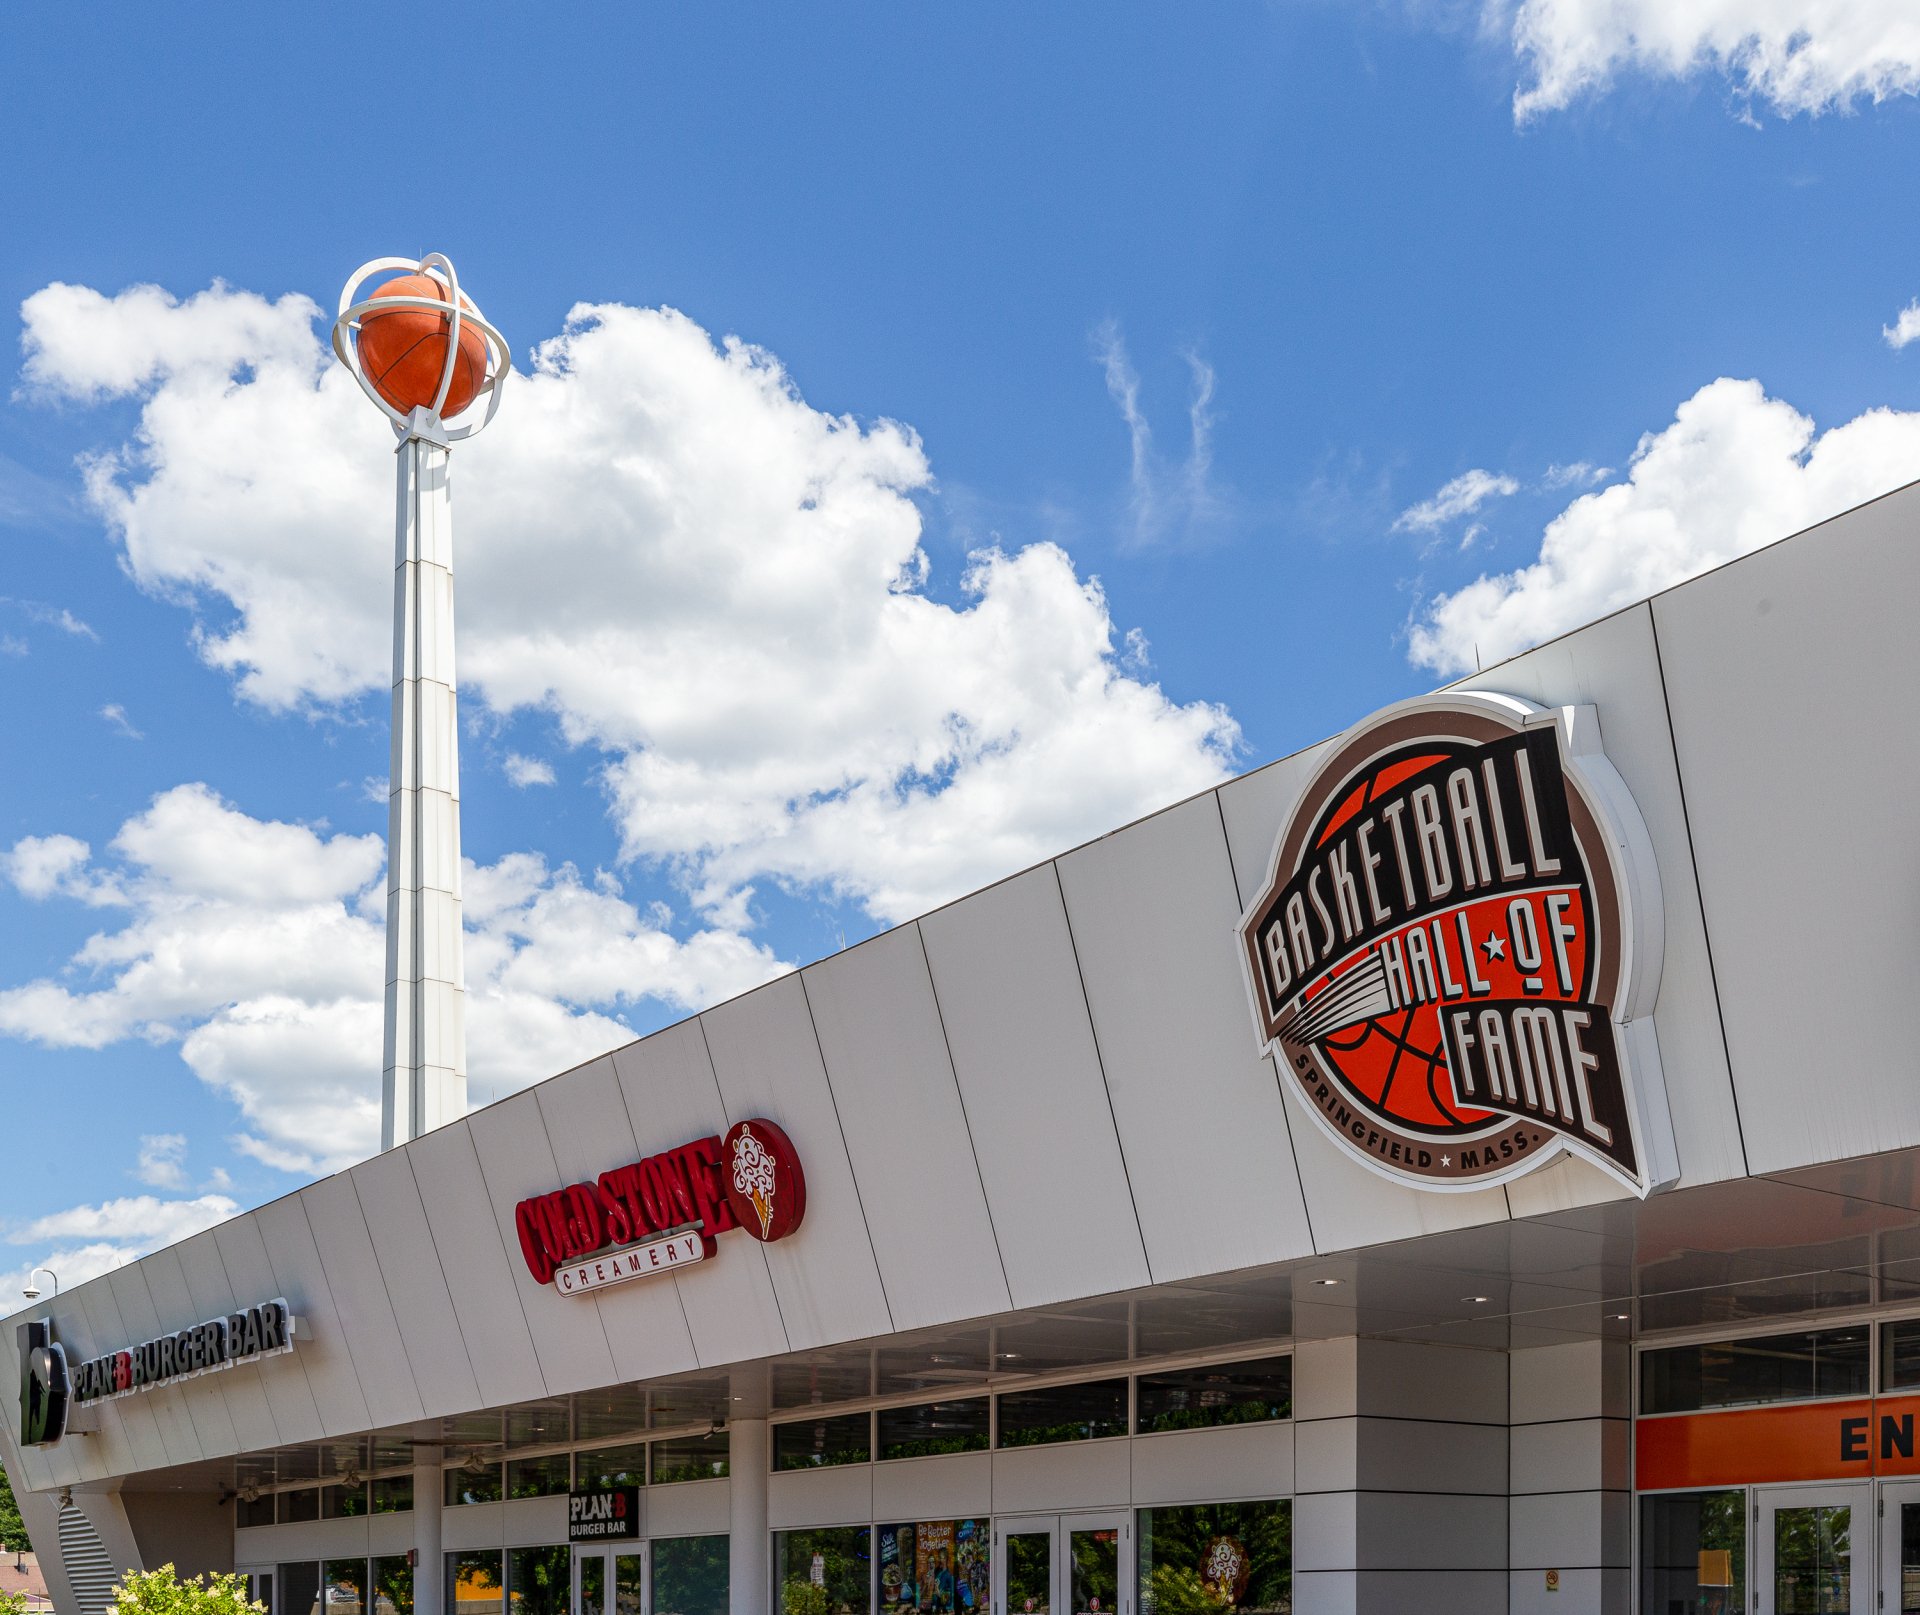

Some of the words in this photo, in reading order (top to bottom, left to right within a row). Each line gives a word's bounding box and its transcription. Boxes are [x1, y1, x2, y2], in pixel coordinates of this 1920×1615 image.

[1264, 748, 1562, 999] BASKETBALL
[1379, 911, 1491, 1010] HALL
[1507, 894, 1576, 996] OF
[1295, 1053, 1432, 1169] SPRINGFIELD
[1460, 1131, 1539, 1170] MASS.
[1451, 1008, 1612, 1146] FAME
[515, 1181, 602, 1285] COLD
[598, 1134, 736, 1245] STONE
[563, 1237, 696, 1290] CREAMERY
[133, 1321, 225, 1387] BURGER
[228, 1303, 284, 1359] BAR
[570, 1522, 606, 1537] BURGER
[607, 1520, 626, 1534] BAR
[919, 1538, 950, 1552] Together
[927, 1524, 952, 1538] Better
